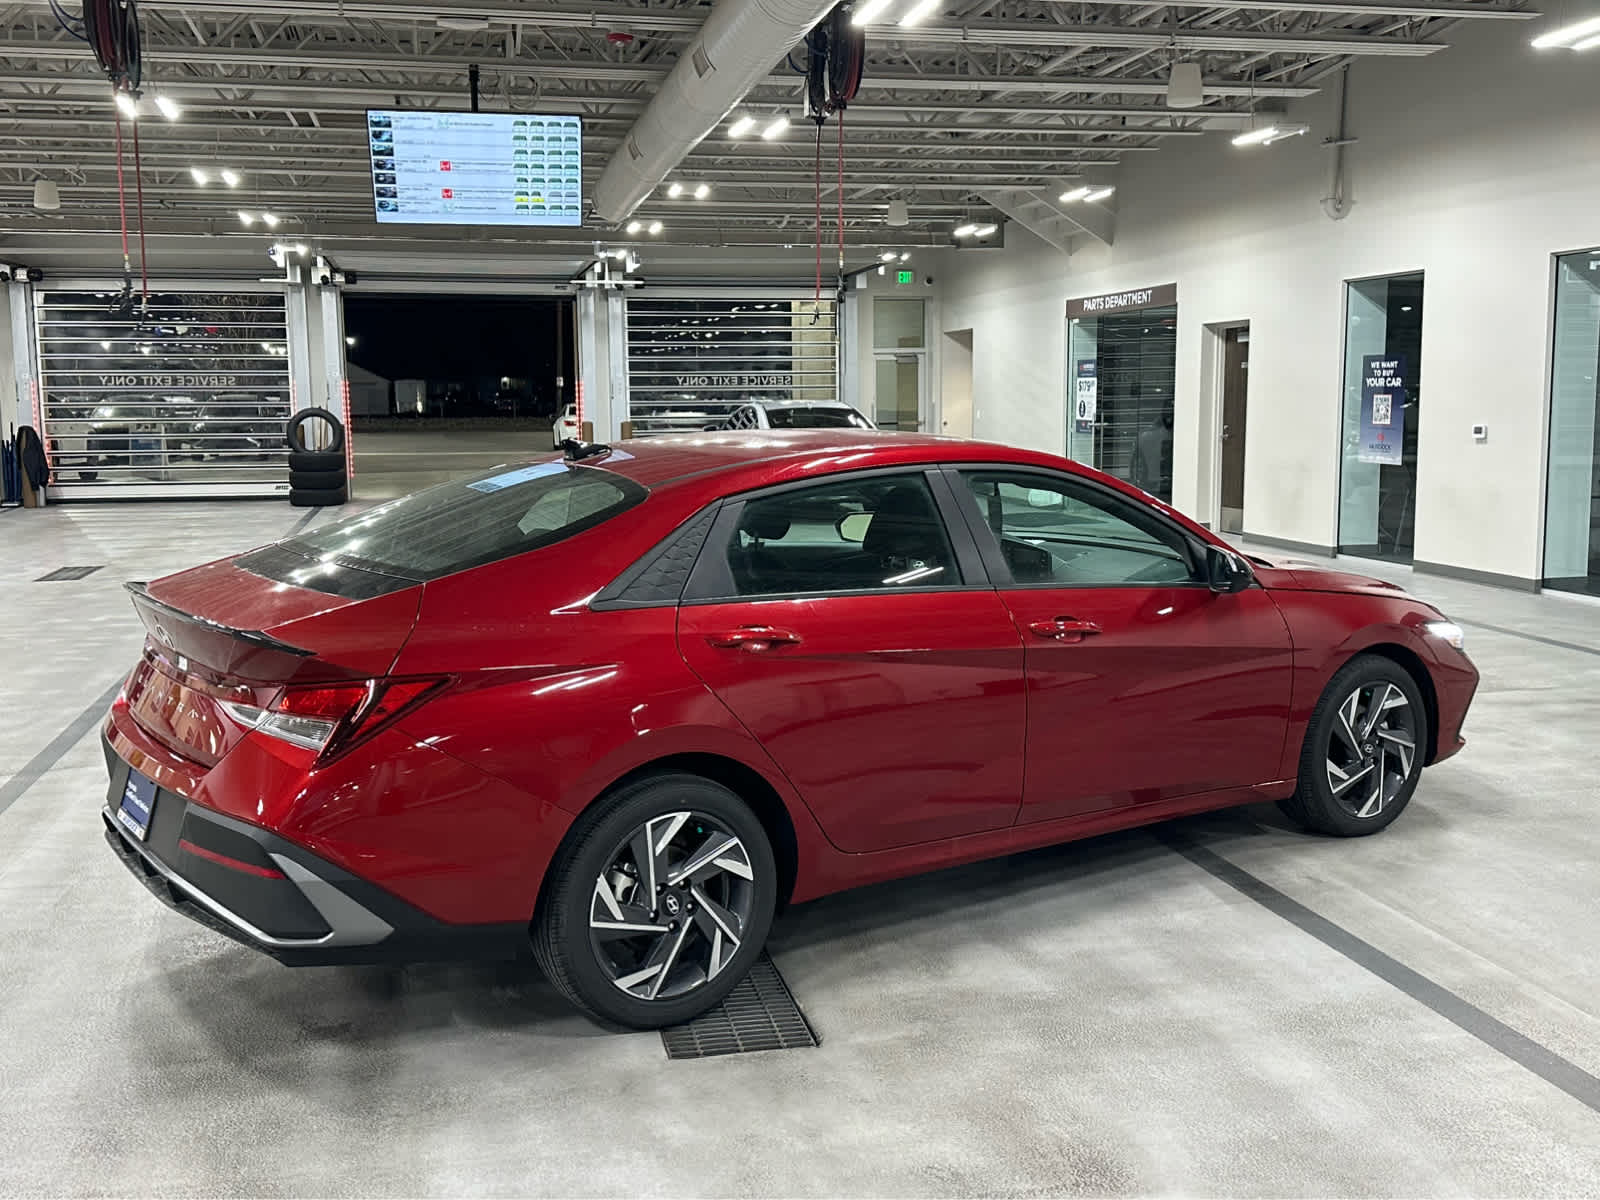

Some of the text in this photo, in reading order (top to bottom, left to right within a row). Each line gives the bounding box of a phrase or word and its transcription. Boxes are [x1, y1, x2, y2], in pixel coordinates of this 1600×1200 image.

[1083, 290, 1152, 311] PARTS DEPARTMENT
[1371, 361, 1398, 369] WE WANT
[1374, 369, 1394, 377] TO BUY
[1366, 377, 1402, 387] YOUR CAR
